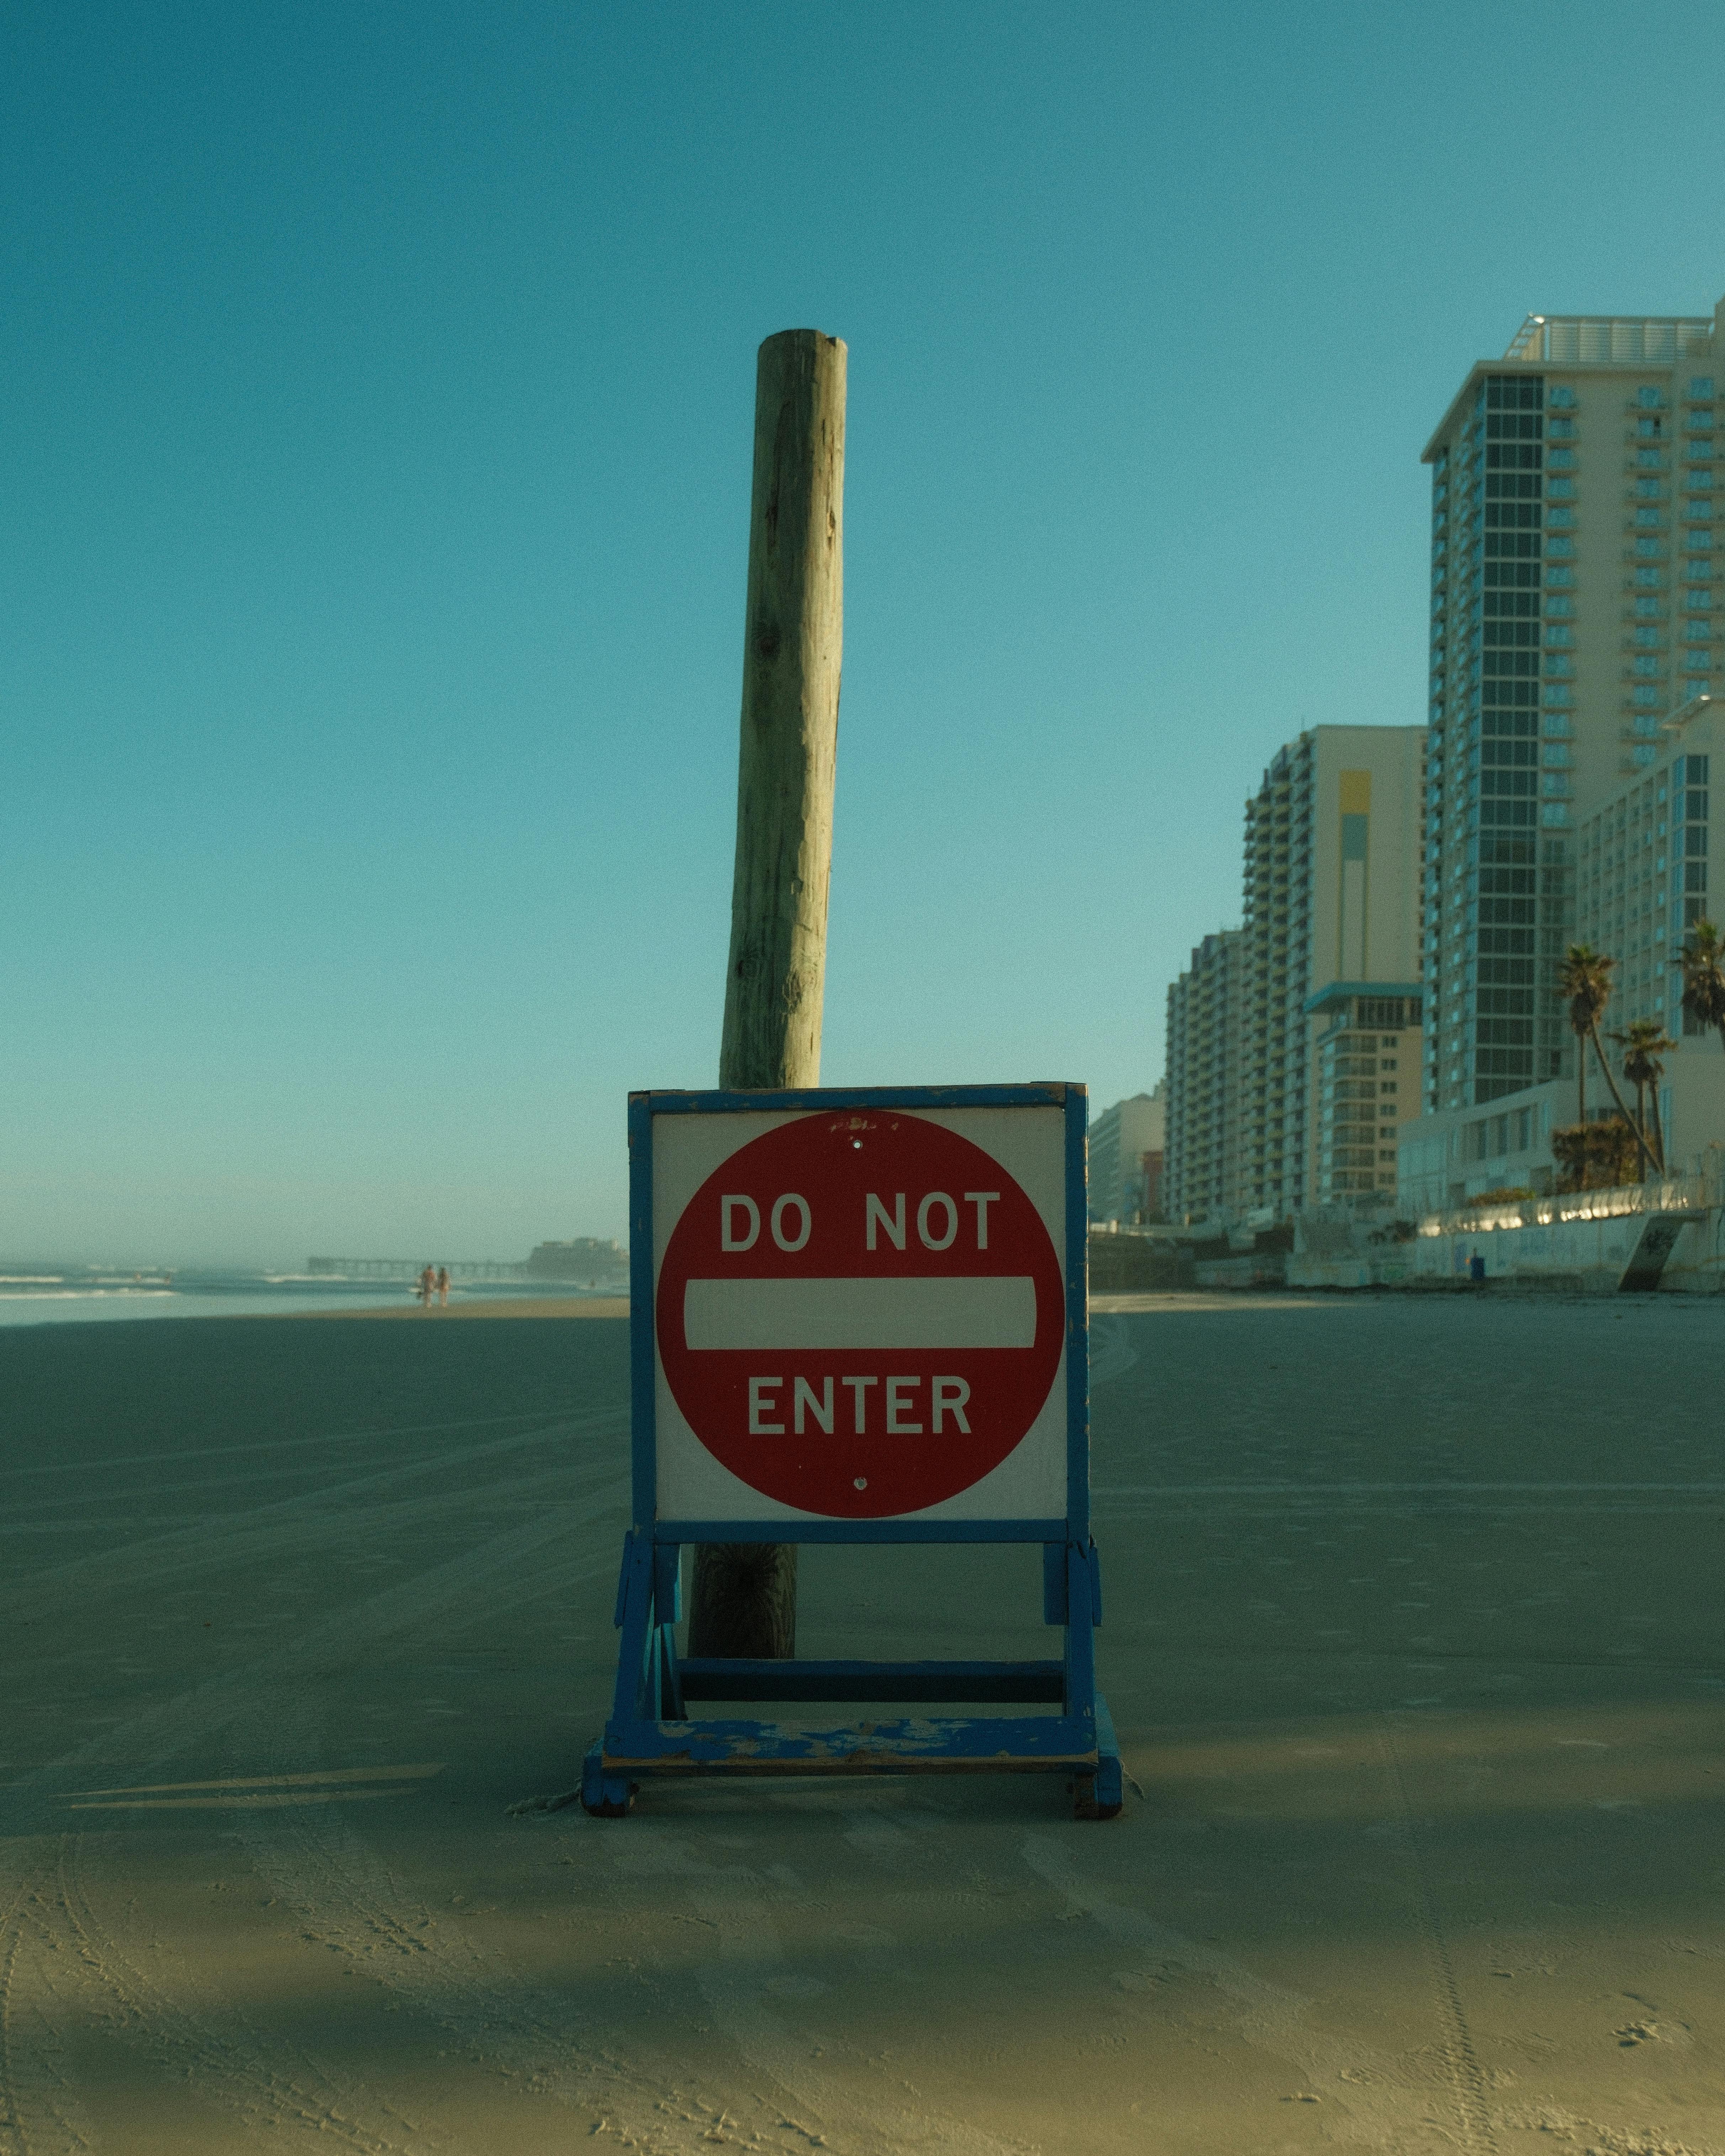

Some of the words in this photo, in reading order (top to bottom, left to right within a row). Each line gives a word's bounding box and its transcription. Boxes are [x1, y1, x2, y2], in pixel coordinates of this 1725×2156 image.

[721, 1193, 811, 1252] DO
[866, 1192, 1000, 1250] NOT
[748, 1376, 971, 1434] ENTER
